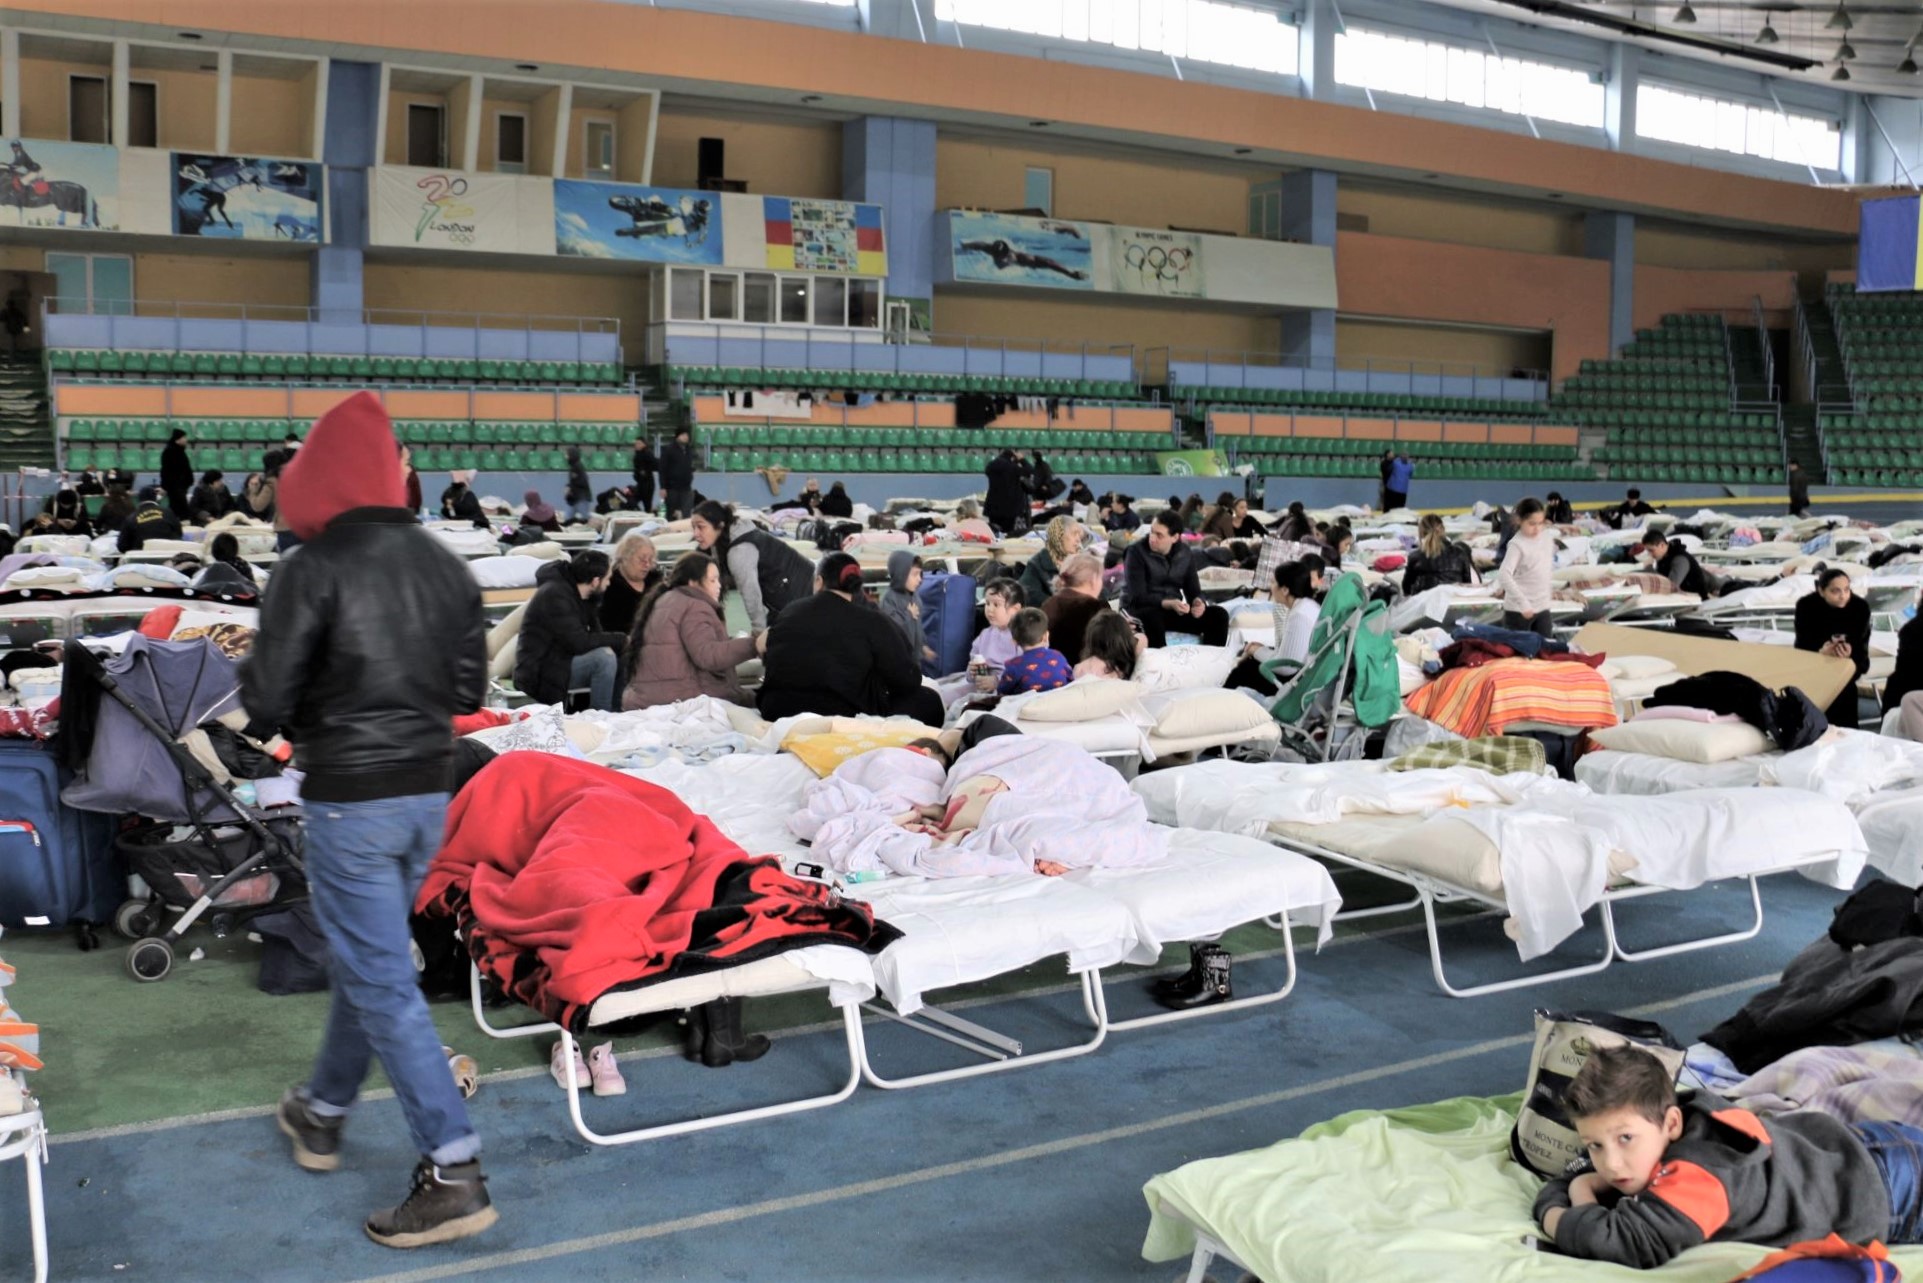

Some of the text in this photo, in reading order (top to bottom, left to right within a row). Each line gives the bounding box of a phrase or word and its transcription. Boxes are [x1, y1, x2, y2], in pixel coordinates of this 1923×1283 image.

[1561, 1055, 1583, 1066] MON
[1522, 1139, 1552, 1159] TROPEZ
[1534, 1129, 1582, 1155] MONTE CA
